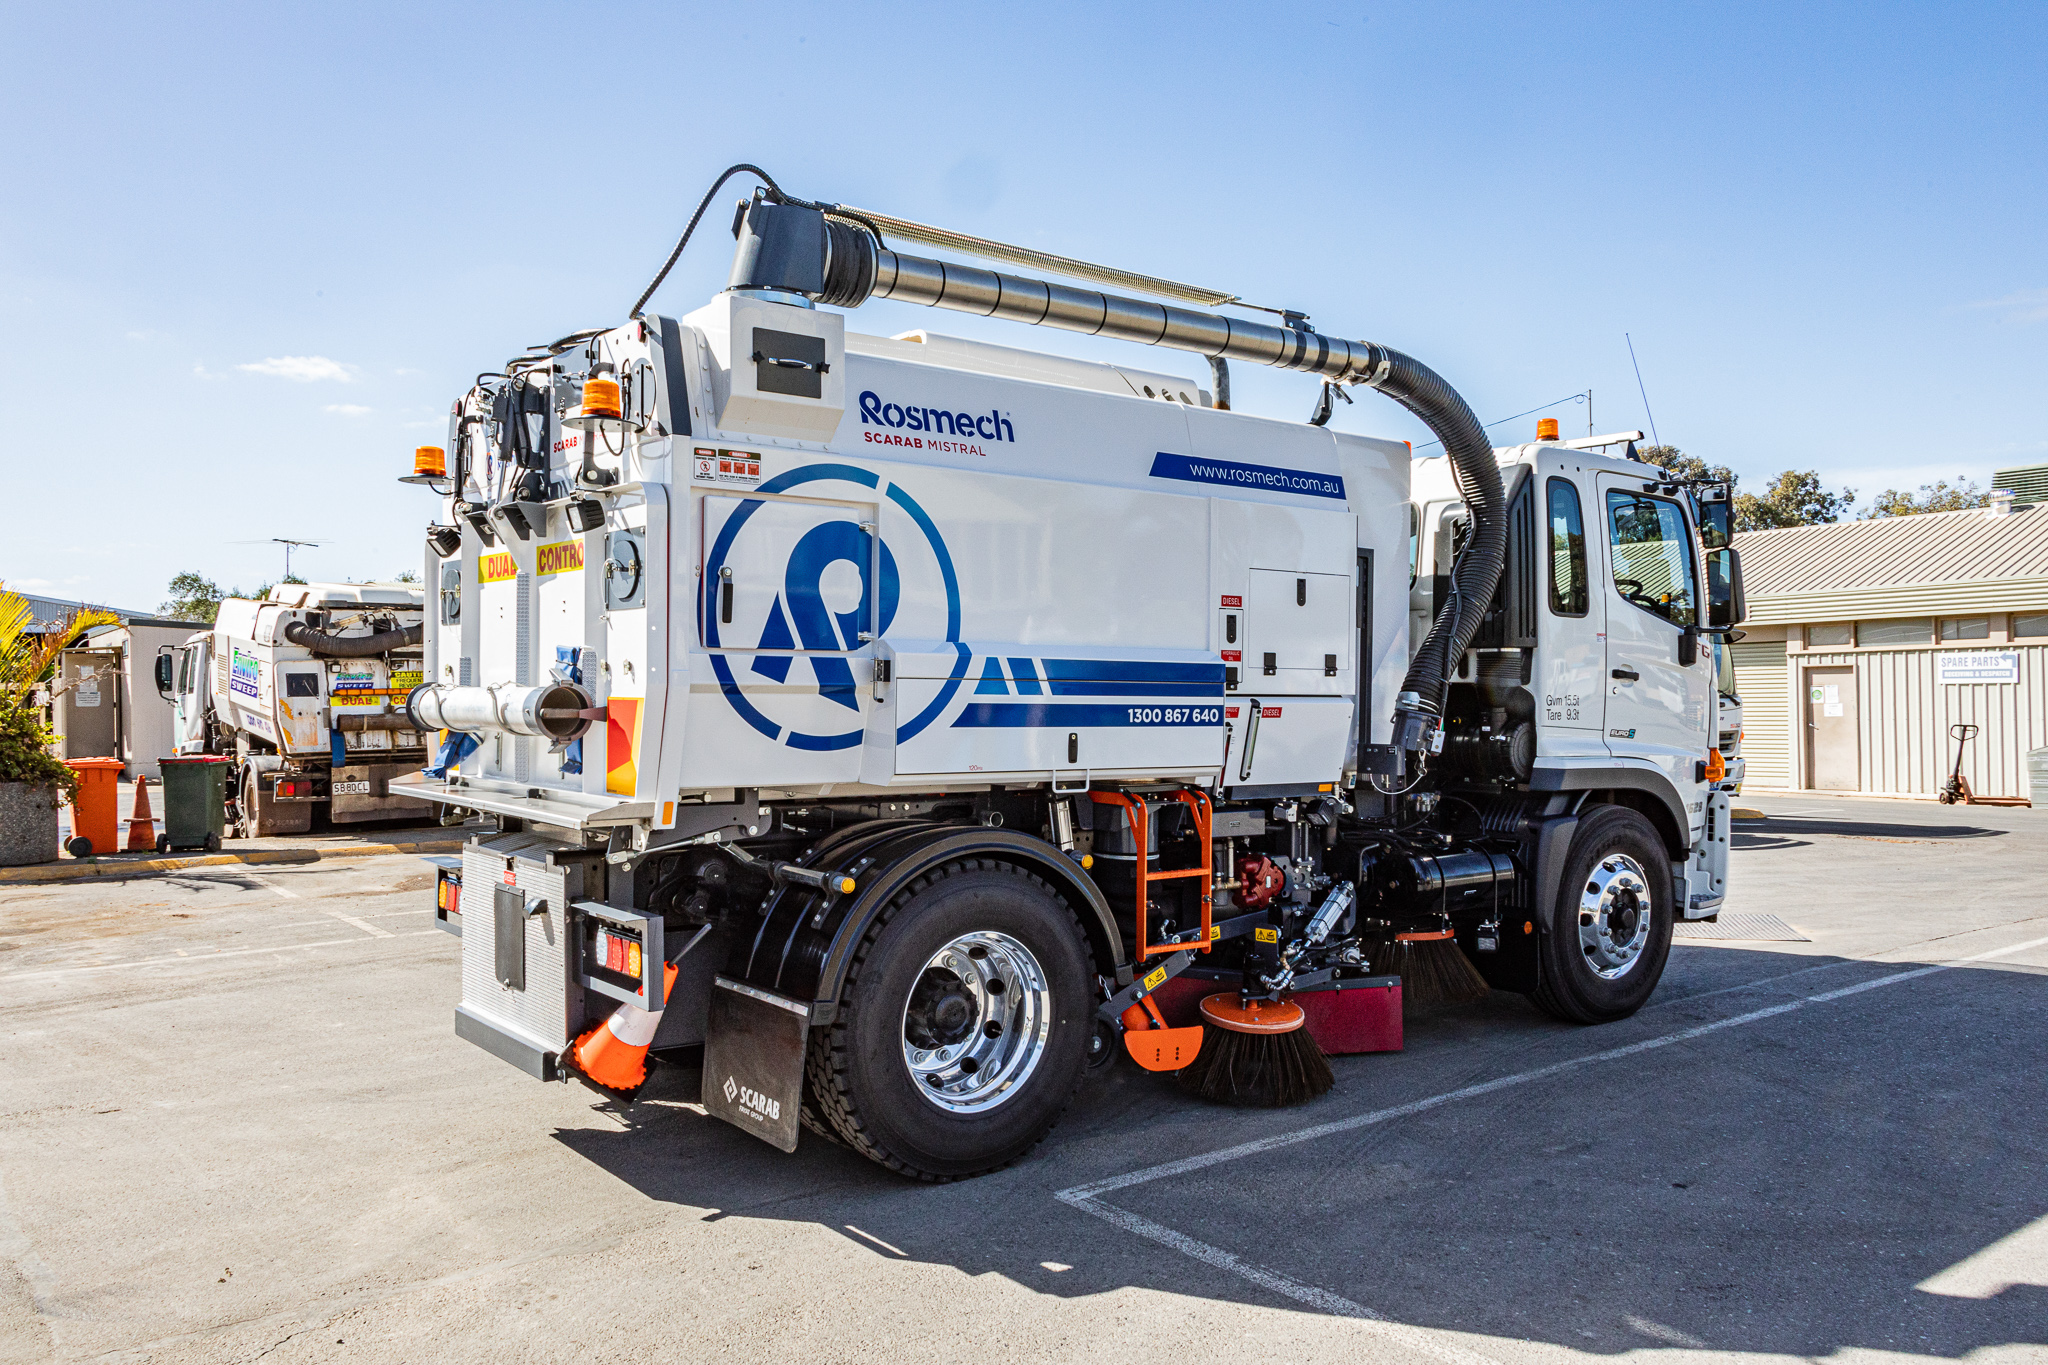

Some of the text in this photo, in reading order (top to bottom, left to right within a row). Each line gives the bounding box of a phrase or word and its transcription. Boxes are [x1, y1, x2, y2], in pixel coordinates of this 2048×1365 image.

[858, 390, 1015, 443] Rosmech
[553, 436, 578, 453] SCARAB
[864, 431, 987, 457] SCARAB MISTRAL
[1189, 463, 1340, 494] www.rosmech.com.au
[488, 541, 584, 579] DUAL CONTRO
[1222, 597, 1241, 605] DIESEL
[1941, 656, 2000, 668] SPARE PARTS
[232, 680, 257, 696] SWEEP
[341, 697, 372, 706] DUAL
[1546, 694, 1579, 706] Gvm 15.5t
[1128, 708, 1219, 723] 1300 867 640
[1546, 709, 1579, 720] Tare 9.3t
[740, 1086, 780, 1120] SCARAB
